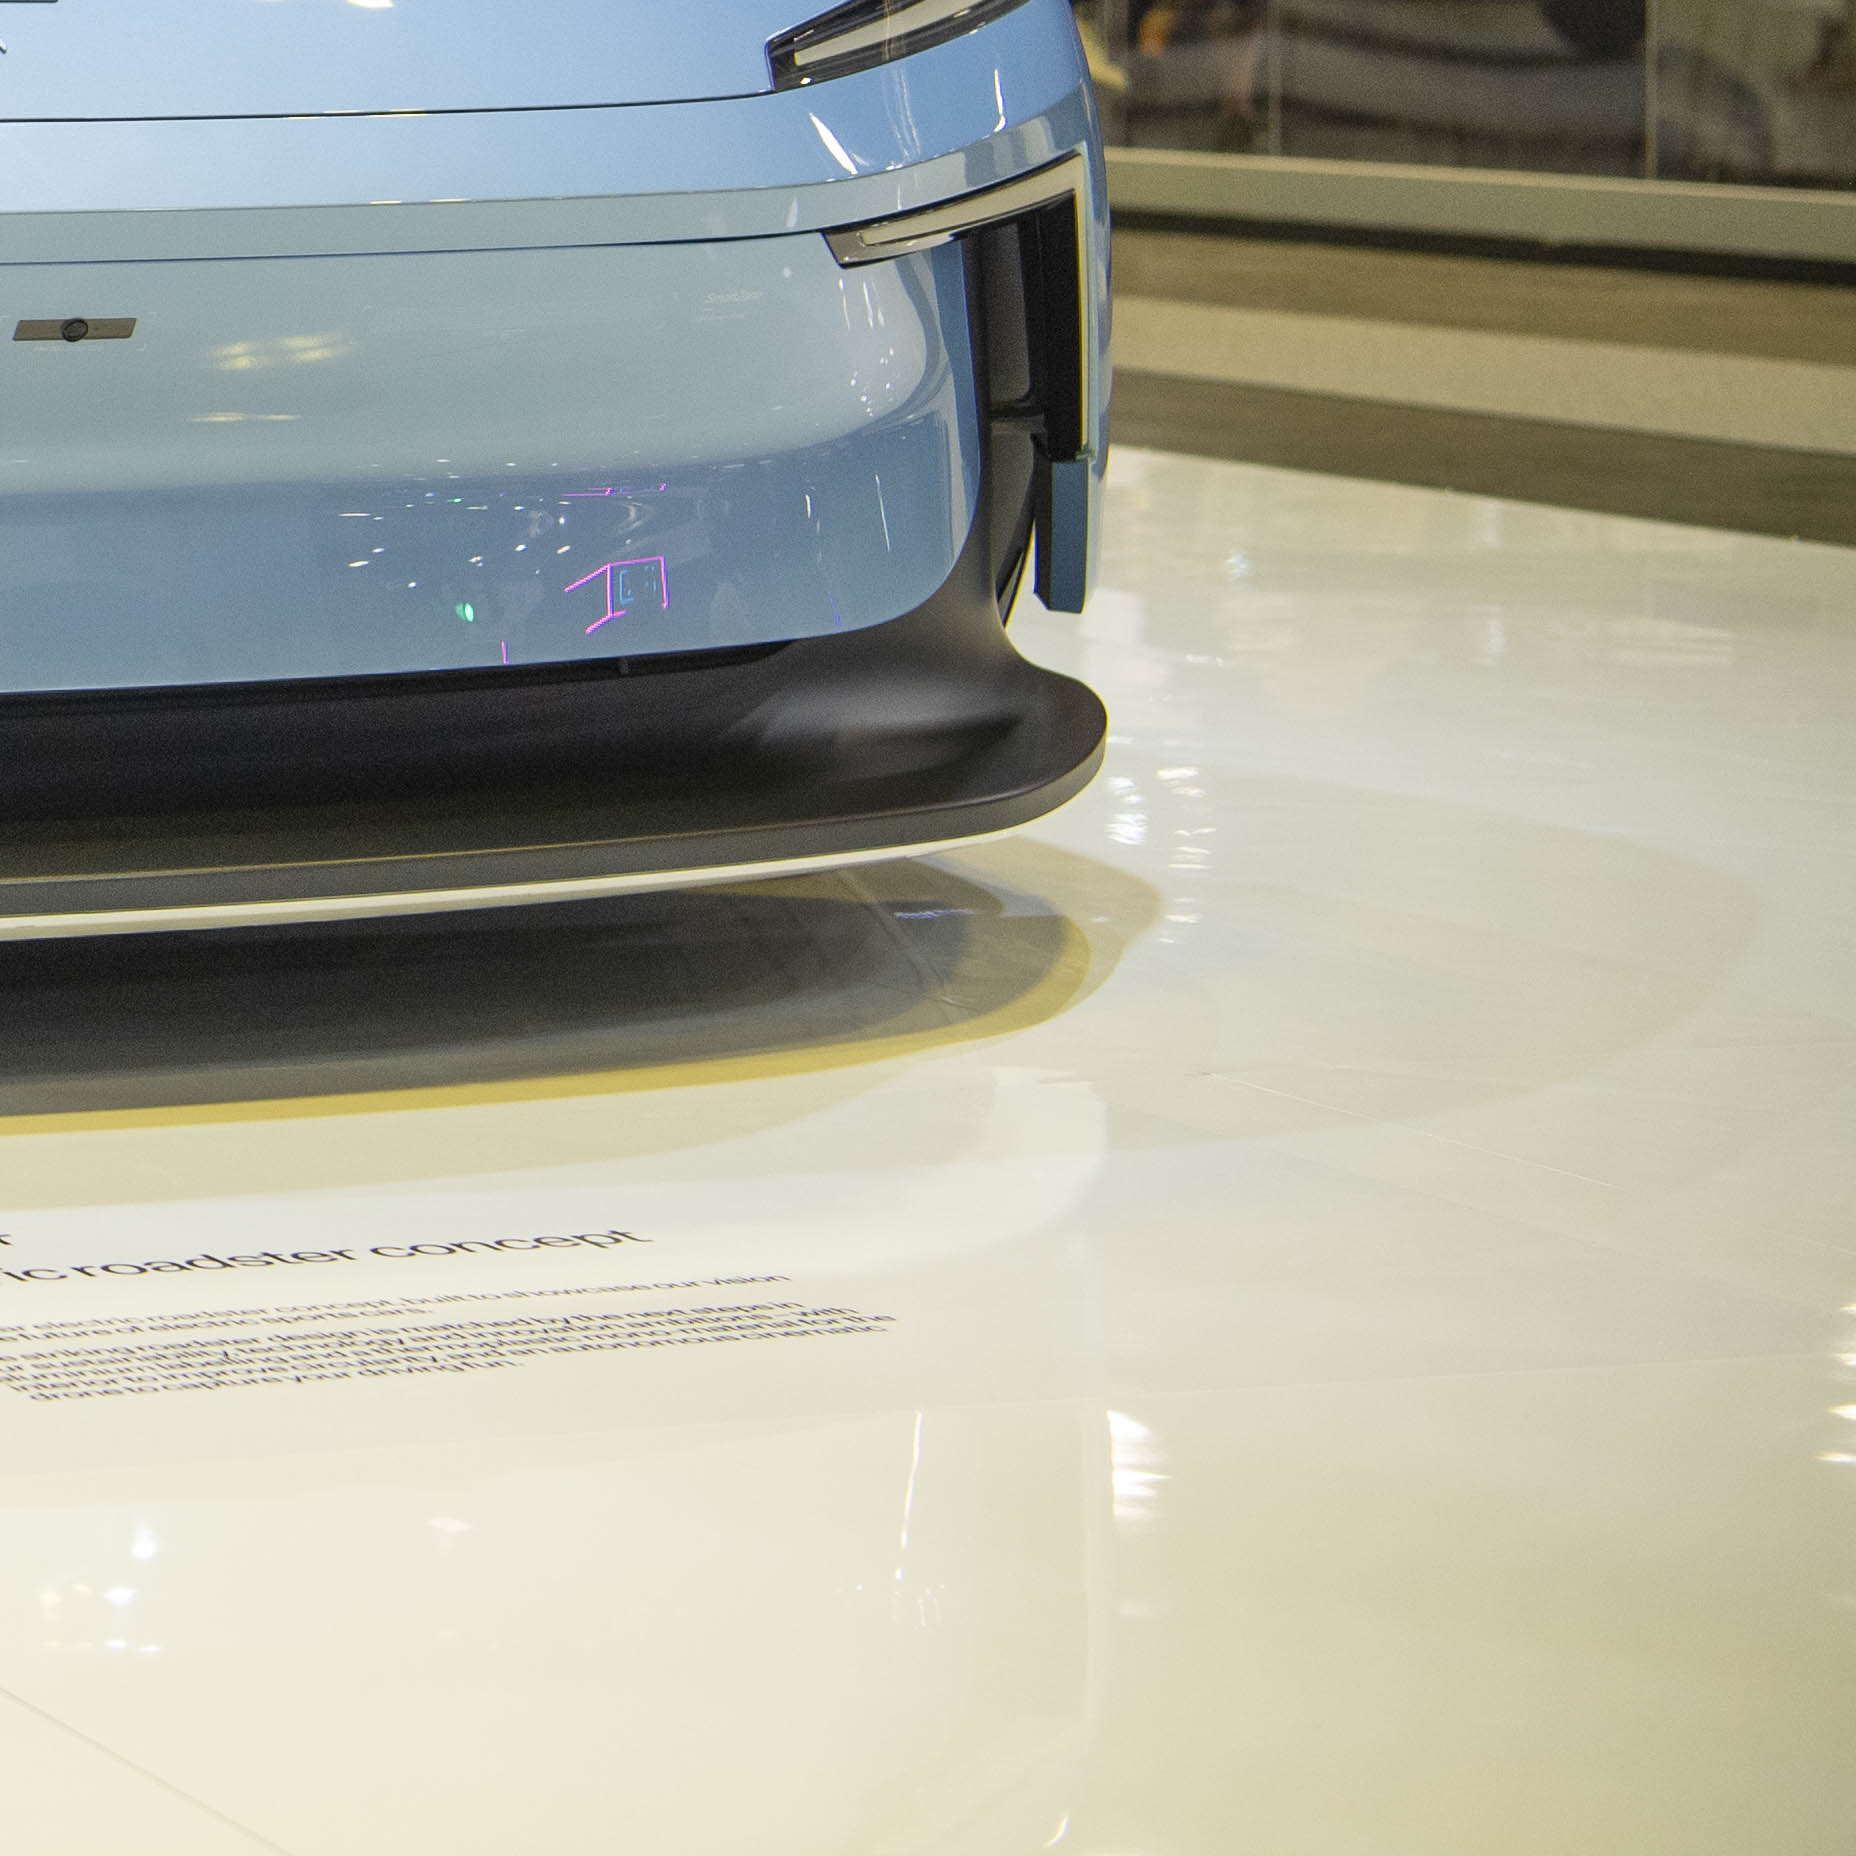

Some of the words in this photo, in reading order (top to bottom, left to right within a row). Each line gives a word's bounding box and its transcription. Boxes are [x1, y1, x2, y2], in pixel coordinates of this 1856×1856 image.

[71, 1248, 358, 1277] roadster
[369, 1229, 654, 1259] concept
[17, 1329, 112, 1340] future
[114, 1324, 148, 1333] of
[147, 1318, 260, 1331] electric
[261, 1311, 358, 1324] sports
[360, 1308, 430, 1316] cars.
[32, 1316, 144, 1329] electric
[145, 1308, 273, 1321] roadster
[275, 1298, 408, 1312] concept,
[400, 1294, 467, 1304] built
[466, 1292, 501, 1300] to
[503, 1284, 652, 1298] showcase
[703, 1275, 792, 1285] vision
[19, 1347, 137, 1359] striking
[138, 1338, 263, 1351] roadster
[263, 1330, 370, 1342] design
[367, 1327, 398, 1335] is
[401, 1318, 532, 1333] matched
[531, 1316, 578, 1325] by
[568, 1313, 624, 1321] the
[626, 1308, 689, 1318] next
[690, 1304, 774, 1314] steps
[155, 1356, 291, 1370] labelling
[290, 1350, 349, 1360] and
[840, 1314, 897, 1323] the
[235, 1338, 410, 1354] technology
[409, 1332, 468, 1342] and
[465, 1323, 627, 1338] innovation
[626, 1314, 774, 1328] ambitions
[791, 1306, 860, 1317] with
[7, 1378, 124, 1391] interior
[123, 1375, 160, 1383] to
[158, 1366, 289, 1380] improve
[447, 1349, 506, 1359] and
[550, 1335, 743, 1352] autonomous
[742, 1324, 888, 1339] cinematic
[22, 1389, 125, 1400] drone
[123, 1385, 158, 1393] to
[162, 1377, 283, 1390] capture
[285, 1372, 354, 1383] your
[354, 1364, 466, 1376] driving
[461, 1361, 524, 1369] fun.
